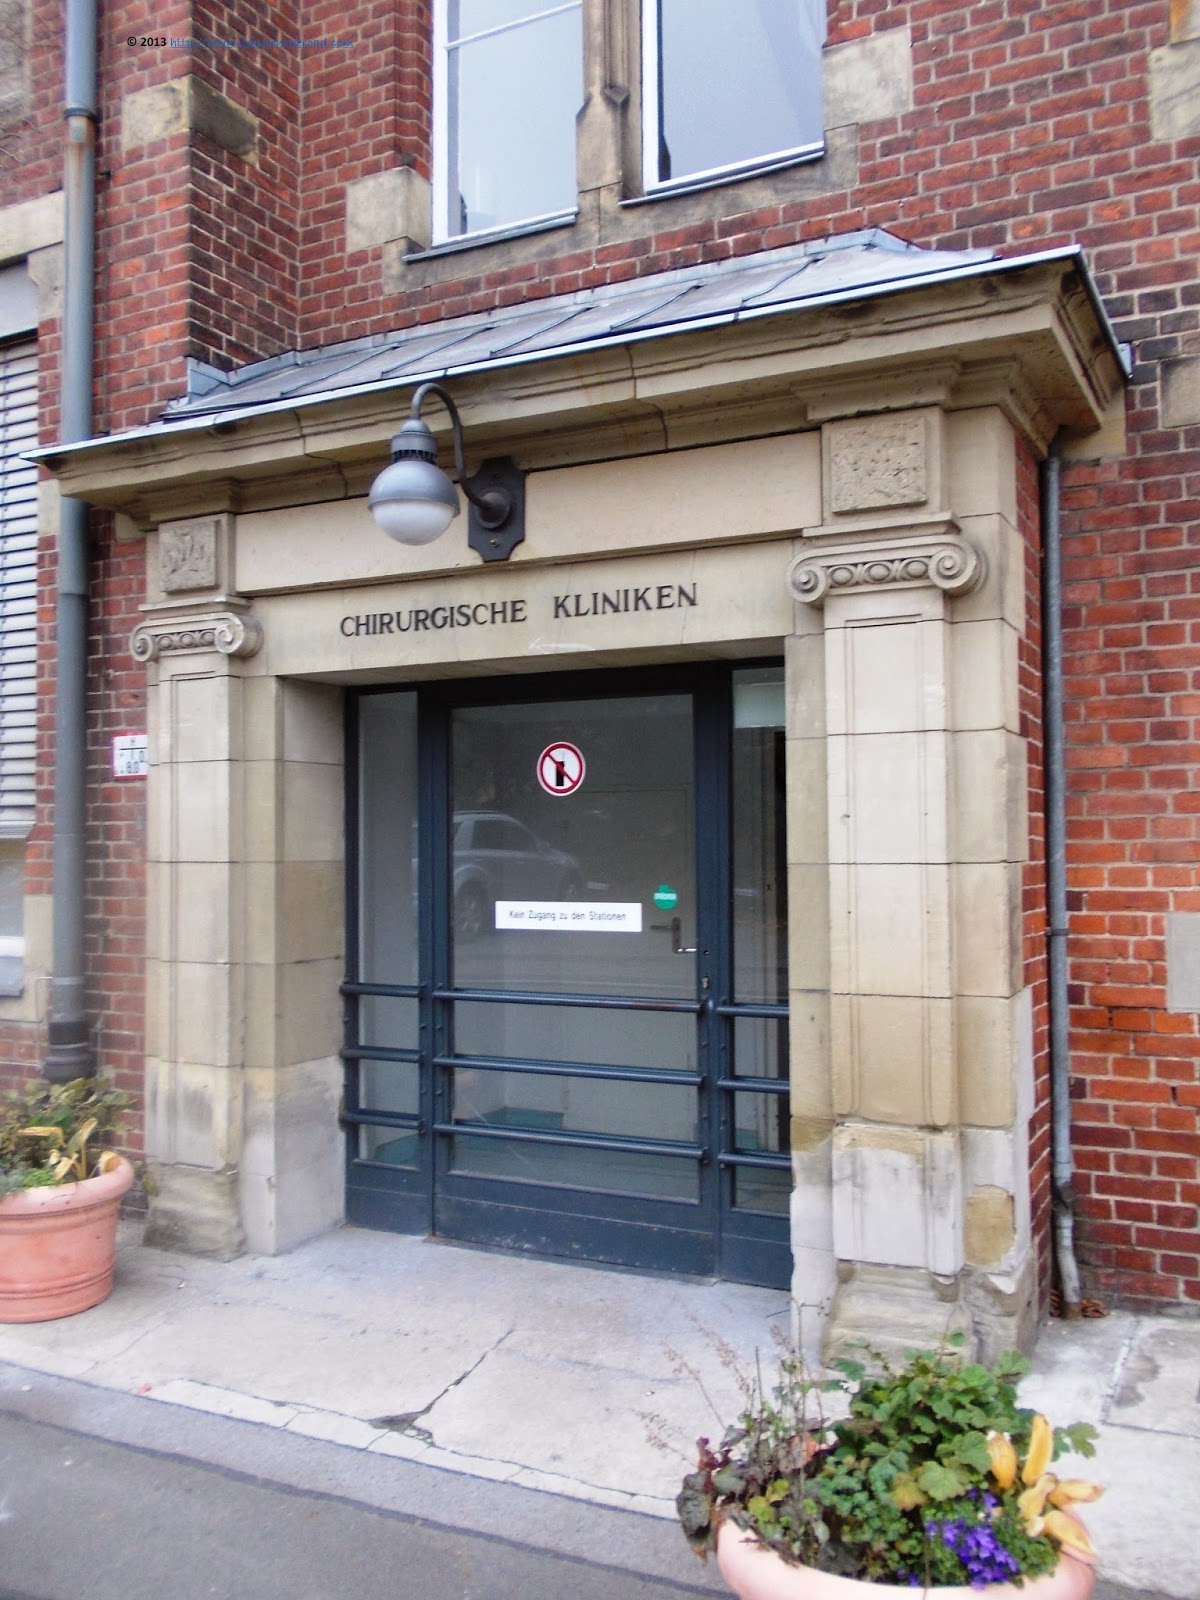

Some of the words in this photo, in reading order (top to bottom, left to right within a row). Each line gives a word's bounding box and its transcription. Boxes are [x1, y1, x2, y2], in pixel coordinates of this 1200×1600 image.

[339, 599, 528, 637] CHIRURGISCHE
[553, 582, 699, 619] KLINIKEN
[508, 910, 525, 919] Kein
[528, 910, 556, 921] Zugang
[559, 912, 568, 920] zu
[571, 911, 585, 920] den
[589, 910, 626, 921] Stationen
